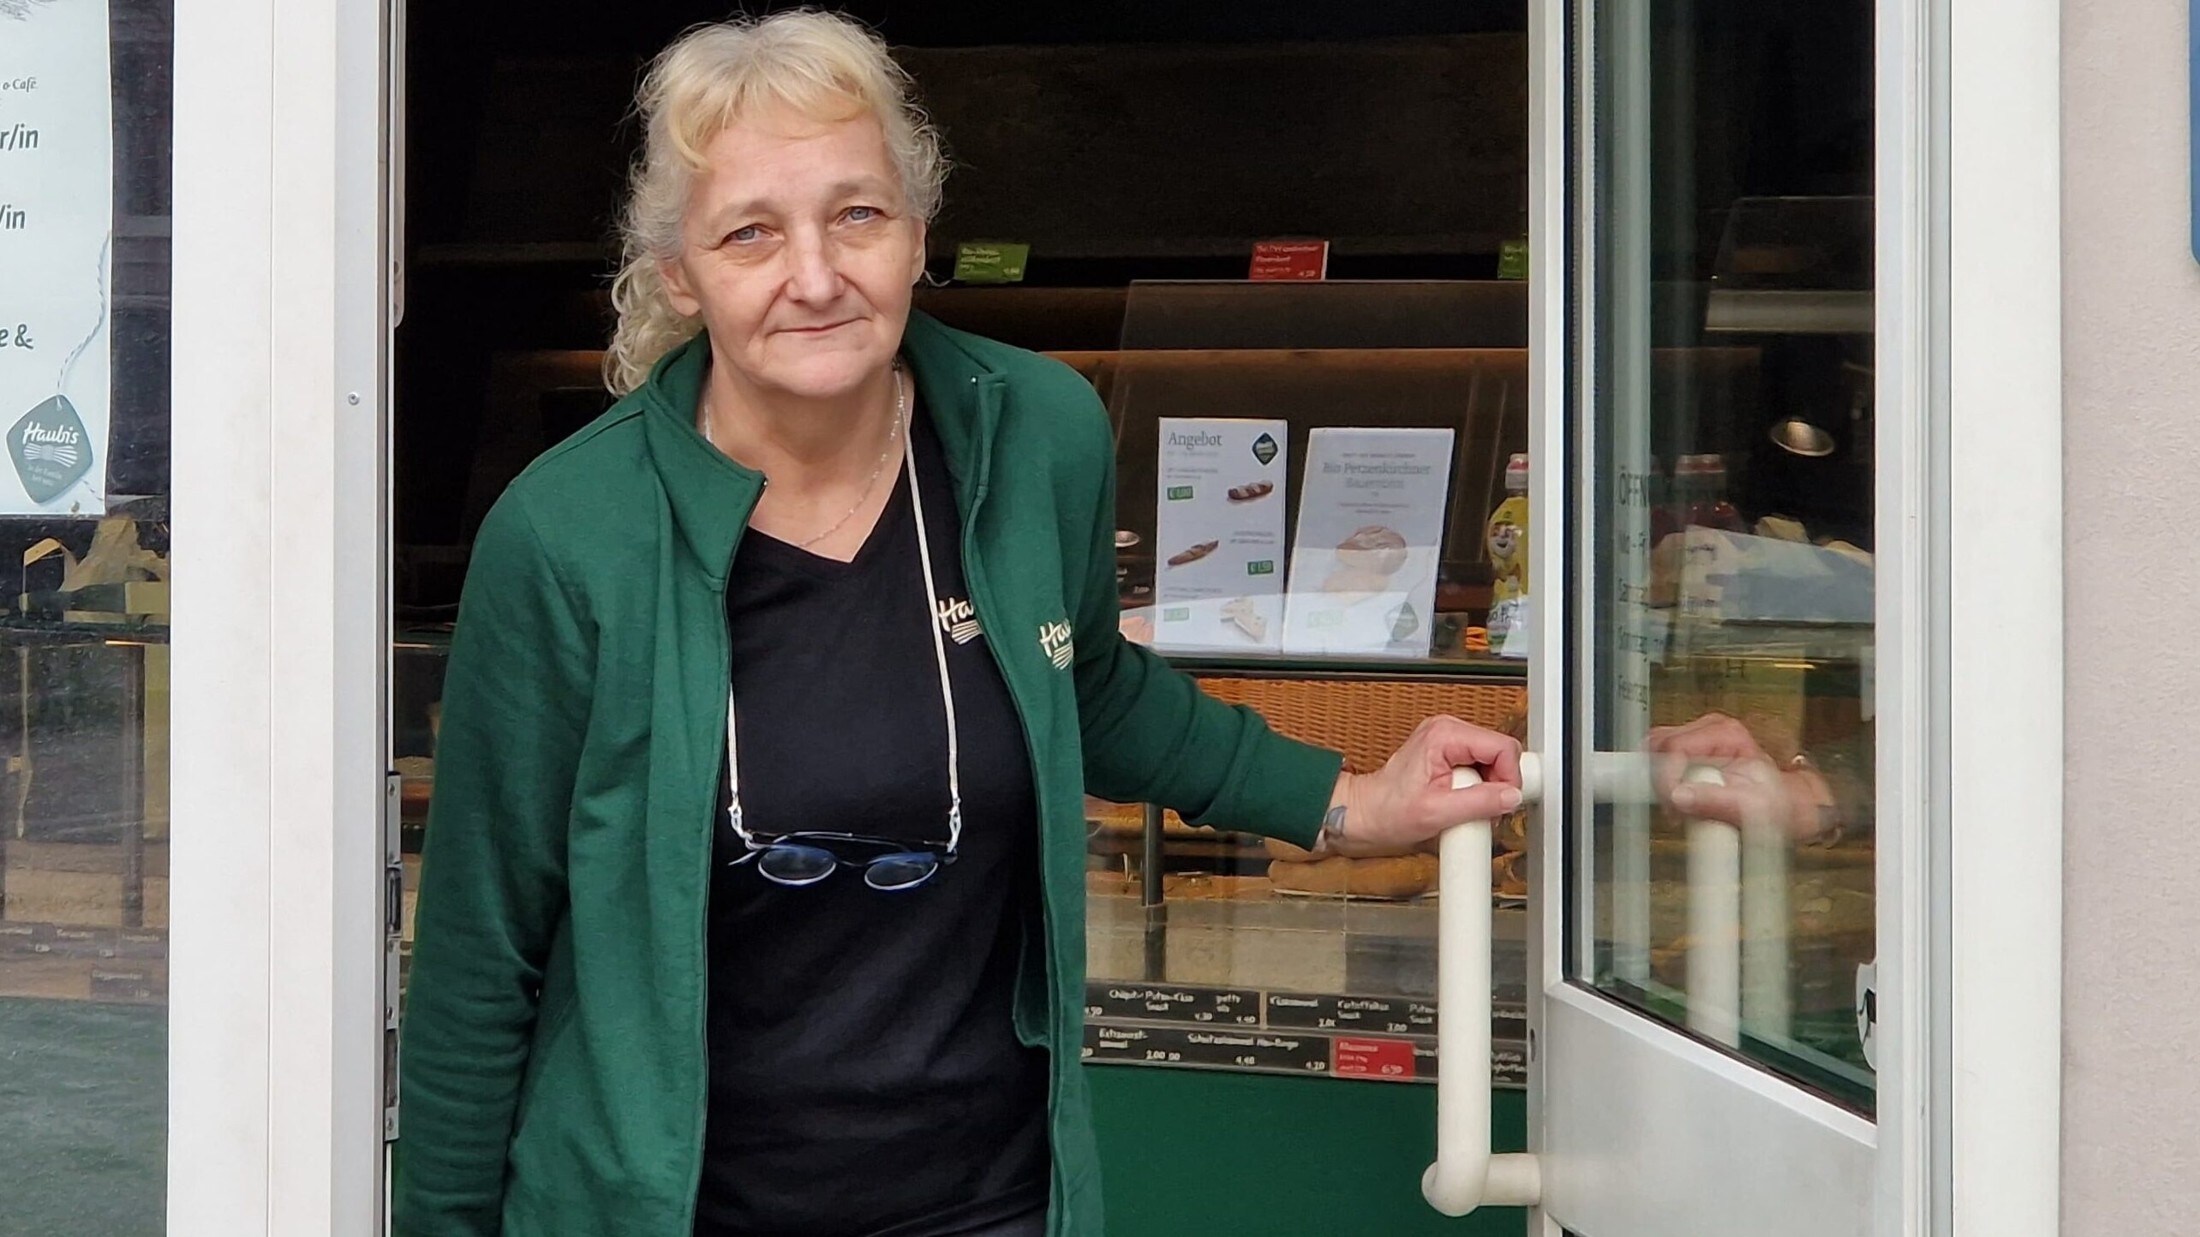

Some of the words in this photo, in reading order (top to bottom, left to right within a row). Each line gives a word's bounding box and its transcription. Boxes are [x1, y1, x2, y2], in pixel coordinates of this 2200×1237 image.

[14, 324, 34, 349] &
[22, 421, 79, 445] Haubis
[1167, 430, 1223, 450] Angebot
